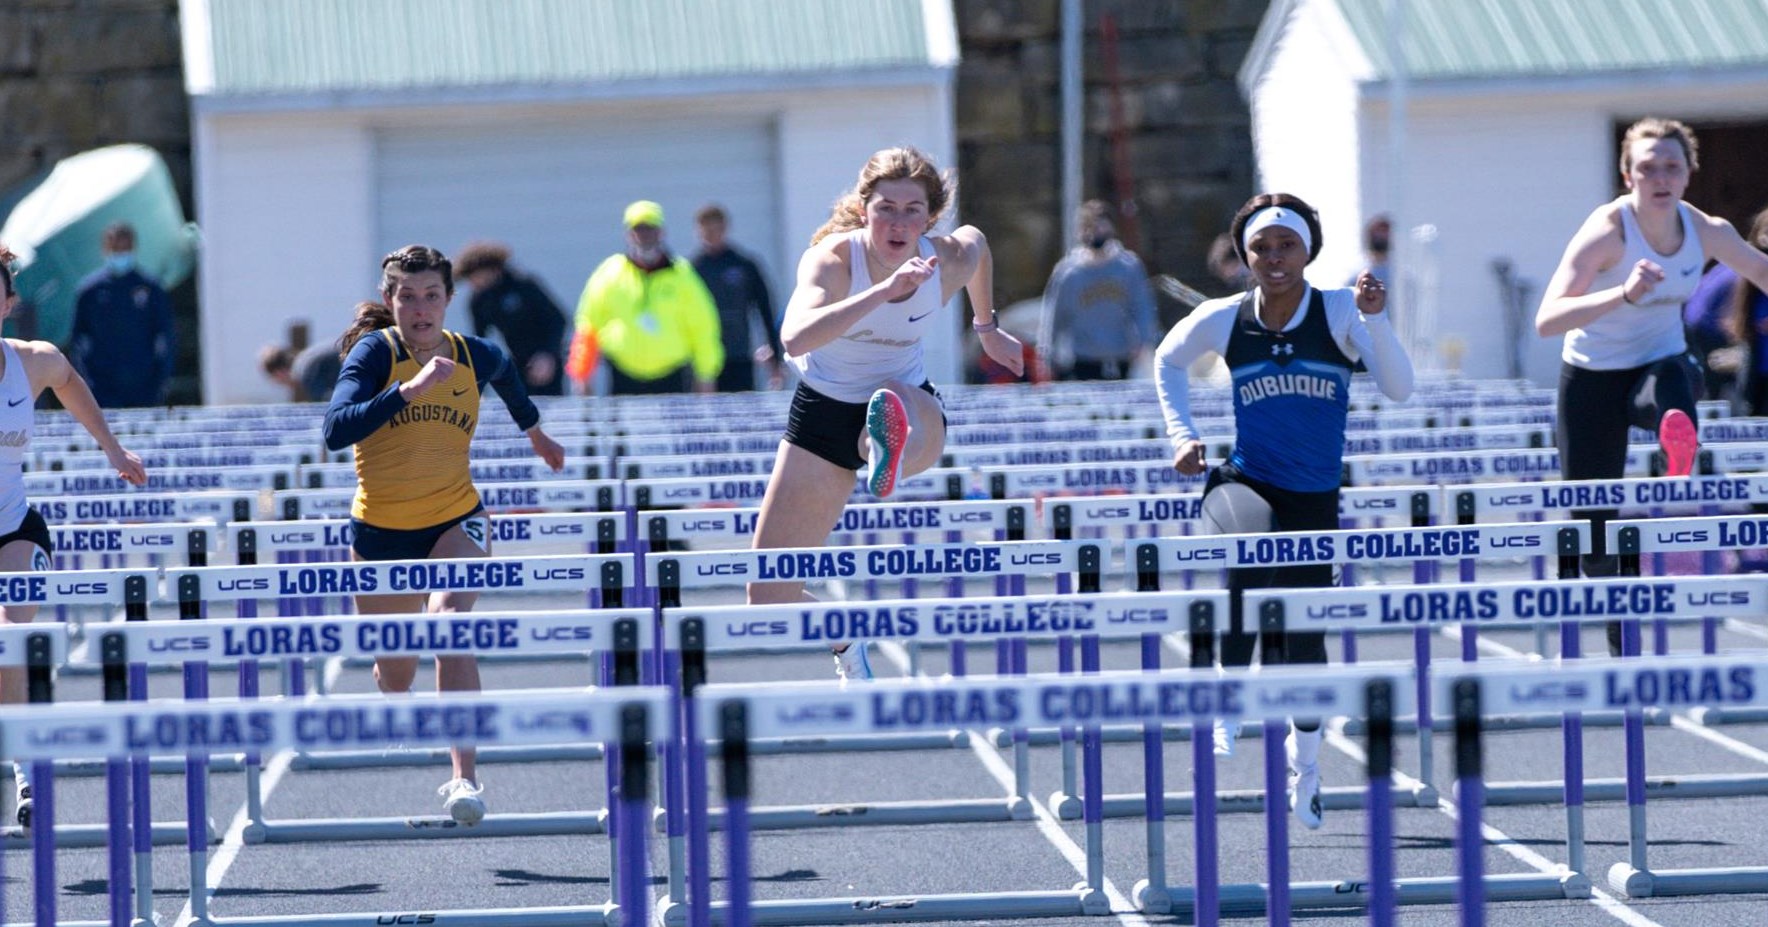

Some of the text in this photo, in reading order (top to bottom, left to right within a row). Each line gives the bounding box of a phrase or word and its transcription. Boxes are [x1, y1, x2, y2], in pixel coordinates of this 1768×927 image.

[1240, 374, 1336, 406] DUBUQUE
[389, 404, 475, 435] AUGUSTANA
[1065, 467, 1137, 487] LORAS
[483, 487, 539, 506] LEGE
[709, 481, 766, 500] LORA
[1490, 479, 1750, 508] UCS LORAS COLLEGE
[76, 500, 176, 519] COLLEGE
[1087, 499, 1203, 521] UCS LORA
[1353, 498, 1396, 509] UCS
[682, 519, 725, 531] UCS
[949, 511, 992, 522] UCS
[271, 532, 315, 544] UCS
[539, 523, 583, 535] UCS
[1657, 530, 1709, 543] UCS
[50, 530, 174, 551] LEGE UCS
[1176, 530, 1541, 565] UCS LORAS COLLEGE UCS
[697, 547, 1062, 579] UCS LORAS COLLEGE UCS
[57, 582, 108, 595] UCS
[218, 562, 585, 594] UCS LORAS COLLEGE UCS
[1307, 583, 1750, 623] UCS LORAS COLLEGE UCS
[727, 602, 1169, 641] UCS LORAS COLLEGE UCS
[148, 618, 593, 656] UCS LORAS COLLEGE UCS
[1603, 666, 1756, 706] LORAS
[870, 686, 1020, 728] LORAS
[1039, 680, 1245, 721] COLLEGE
[124, 711, 274, 750] LORAS
[294, 703, 499, 745] COLLEGE
[376, 913, 437, 926] UCS
